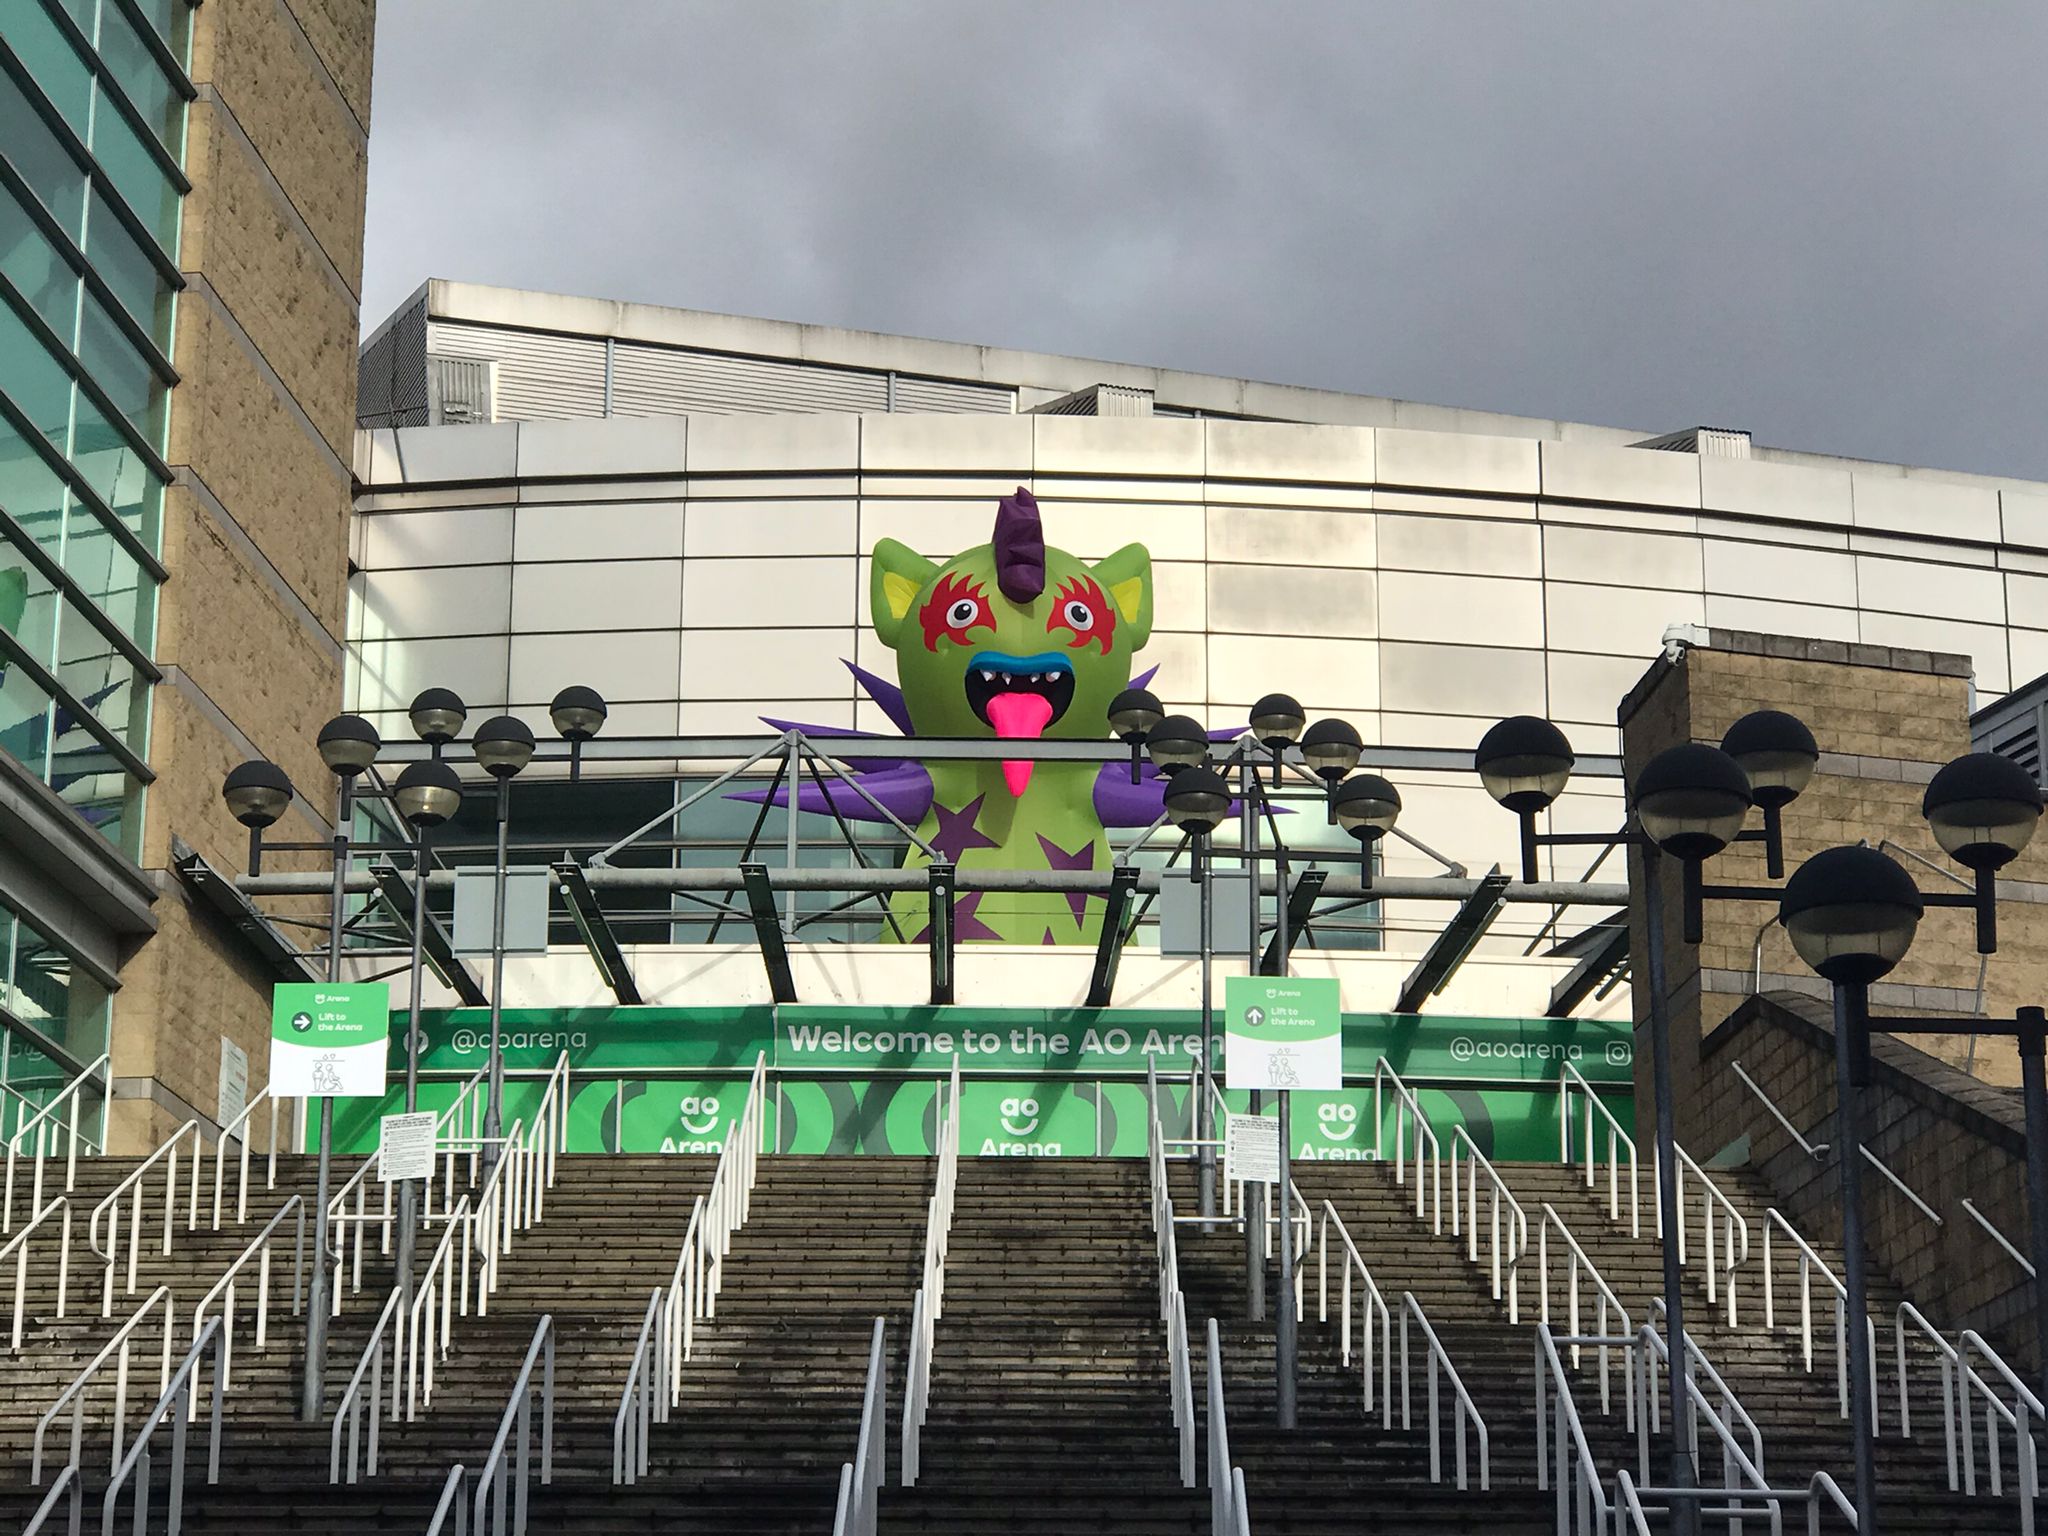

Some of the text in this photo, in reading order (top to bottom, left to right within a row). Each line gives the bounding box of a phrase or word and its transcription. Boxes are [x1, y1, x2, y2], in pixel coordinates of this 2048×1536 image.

[318, 1013, 347, 1021] Lift to
[1271, 1008, 1298, 1016] Lift to
[1288, 1018, 1316, 1026] Arena
[788, 1025, 1226, 1055] Welcome to the AO Aren
[1450, 1036, 1583, 1062] @aoarena
[681, 1097, 720, 1115] ao
[1000, 1098, 1039, 1117] ao
[1318, 1103, 1357, 1122] ao
[659, 1137, 723, 1153] Aren
[979, 1138, 1061, 1156] Arena
